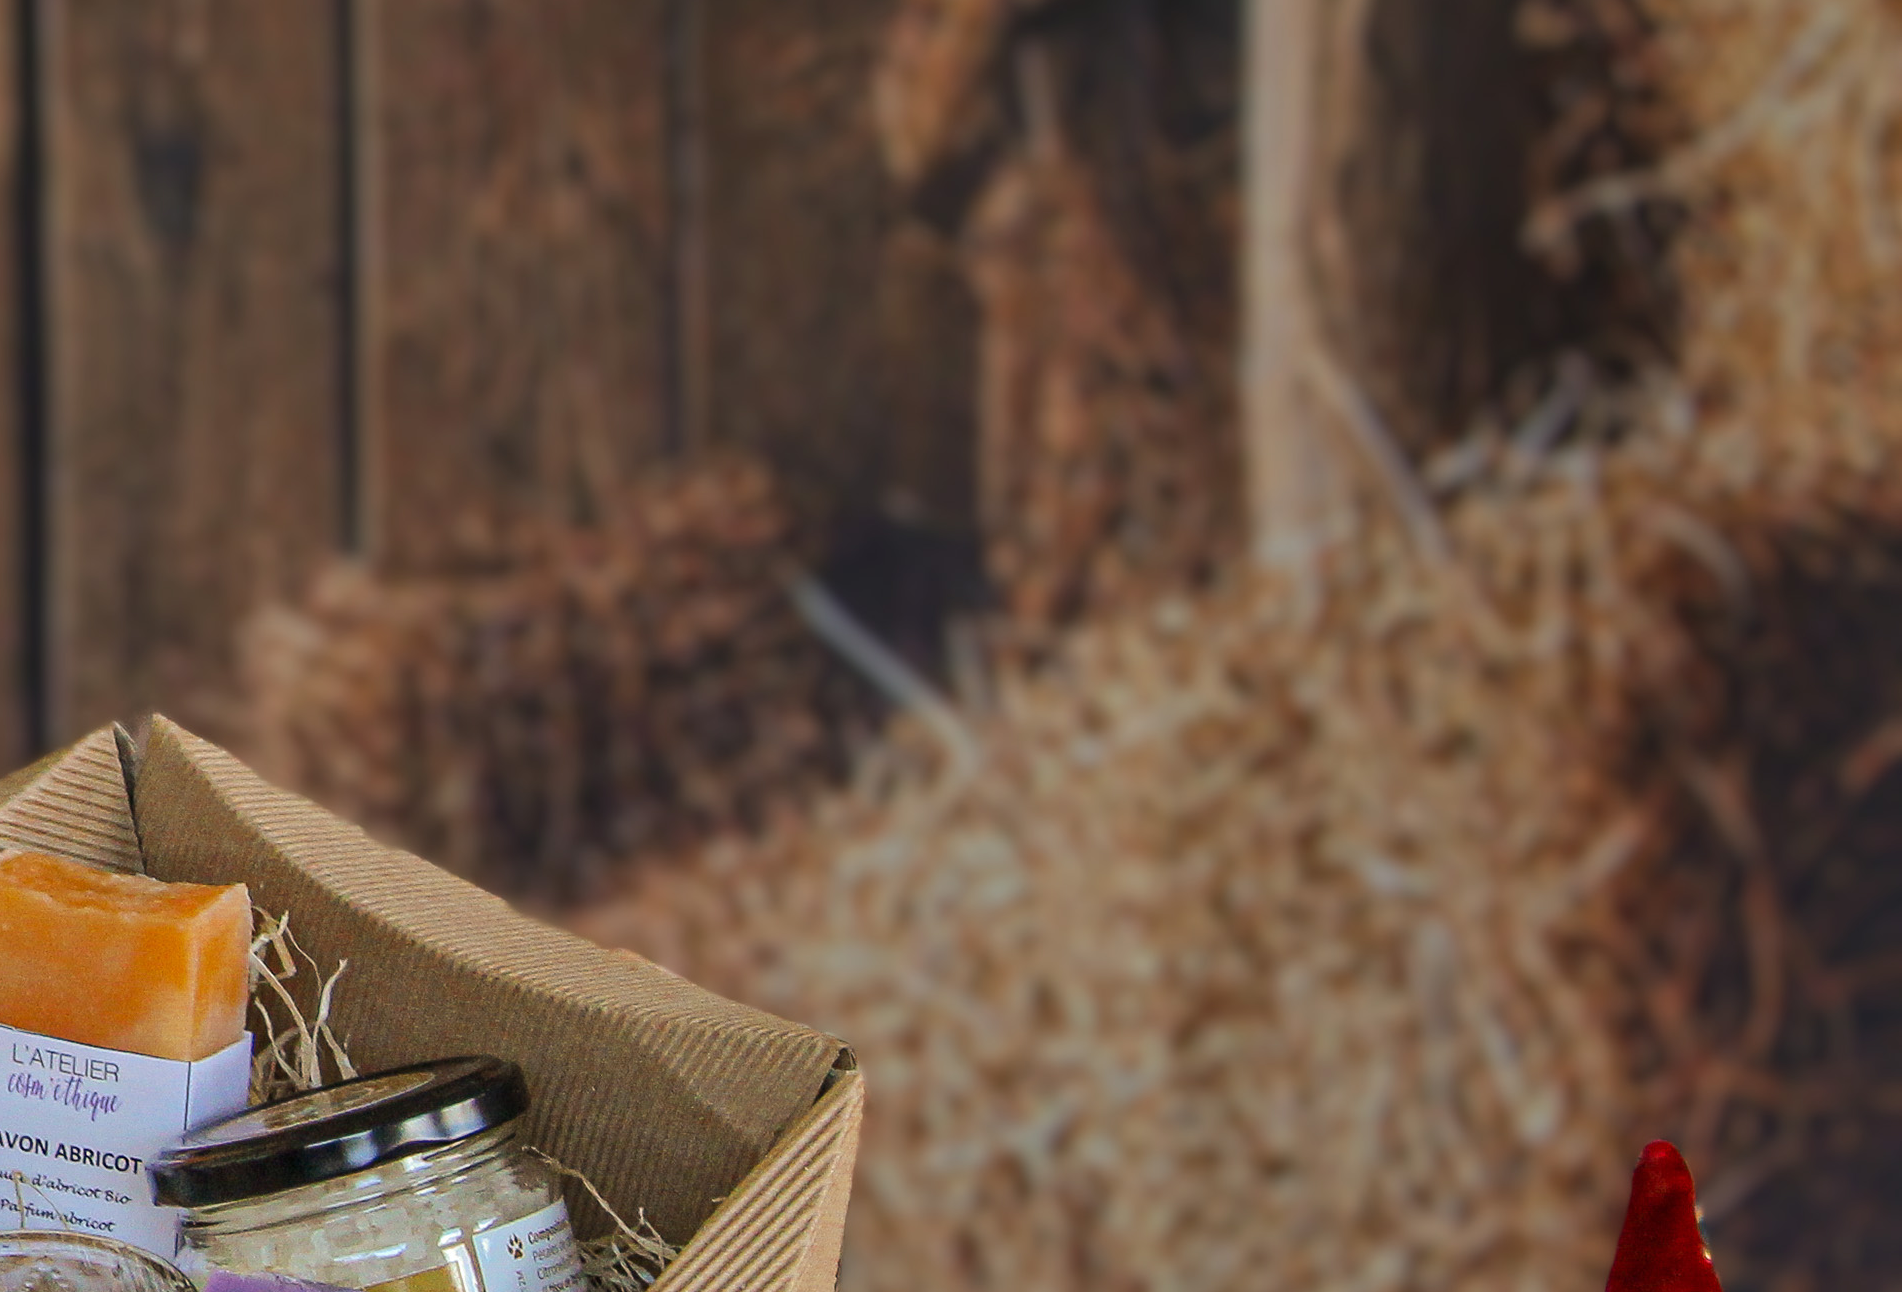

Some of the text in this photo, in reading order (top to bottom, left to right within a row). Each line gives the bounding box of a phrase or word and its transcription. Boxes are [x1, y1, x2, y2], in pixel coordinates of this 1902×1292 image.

[11, 1042, 121, 1084] L'ATELIER
[53, 1143, 144, 1176] ABRICOT
[31, 1173, 133, 1206] d'abricot Bio
